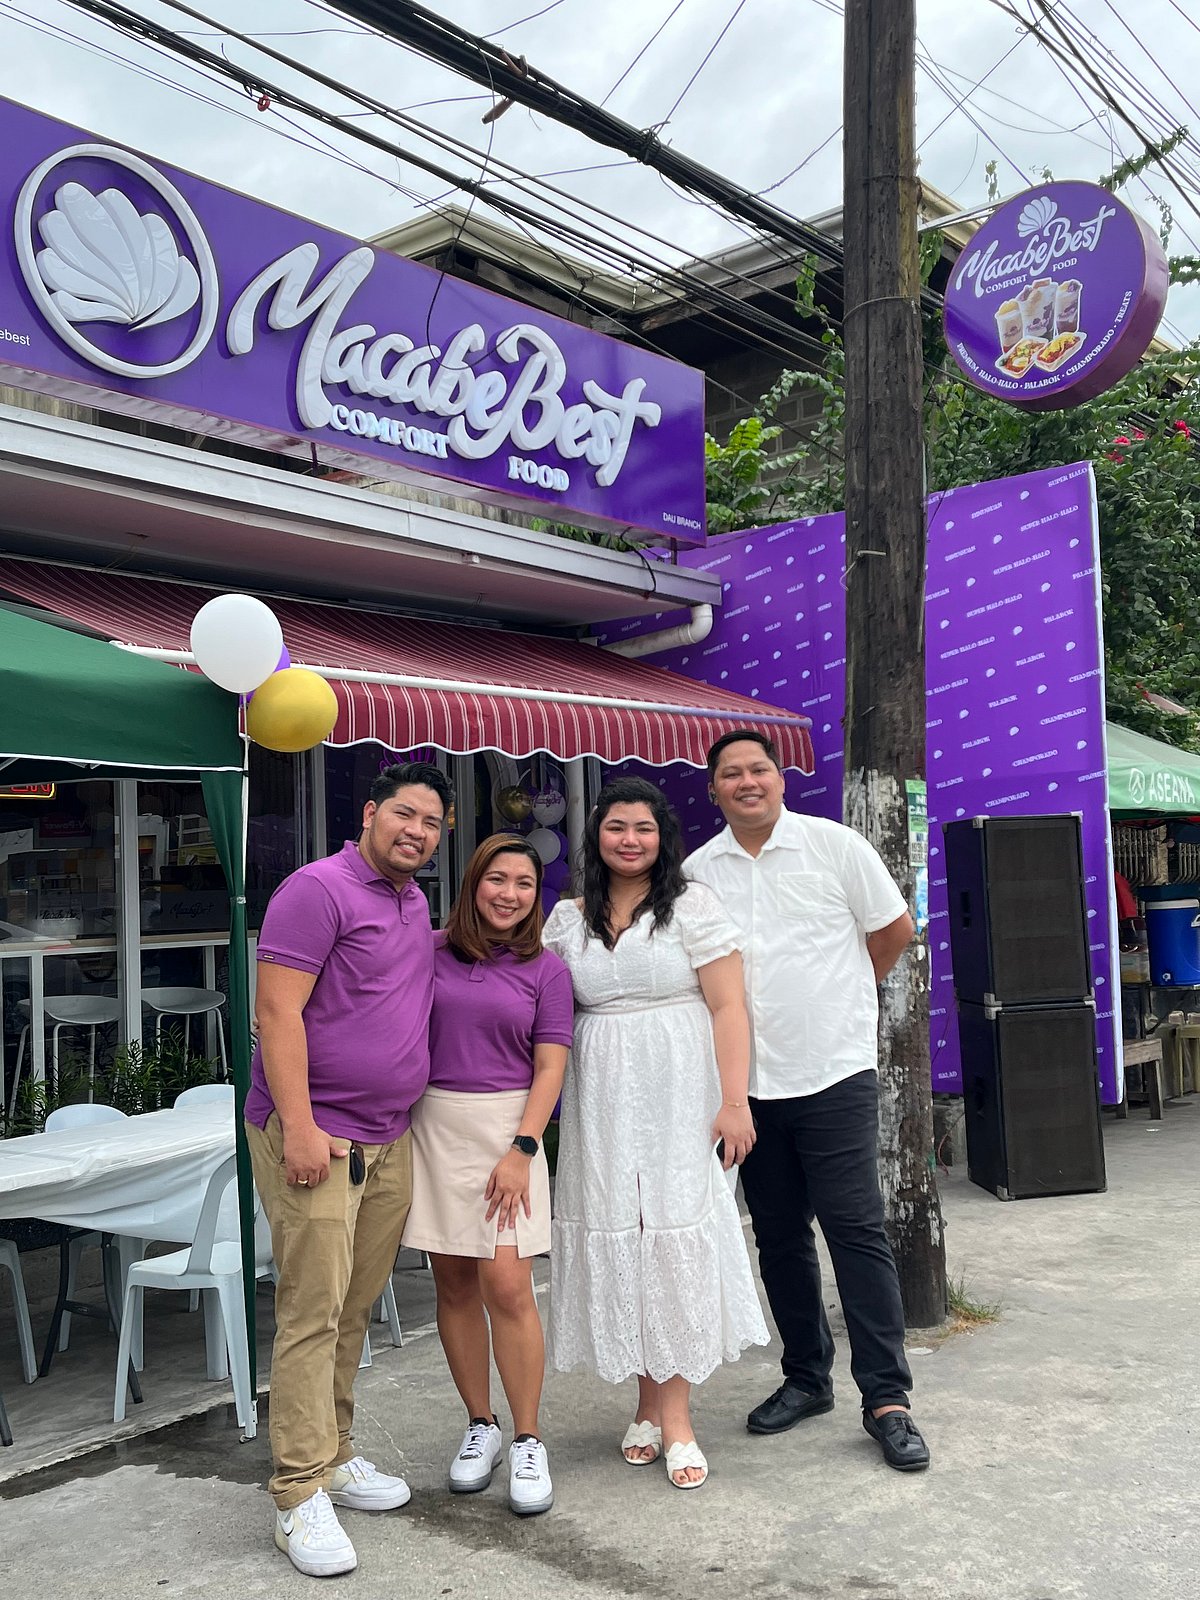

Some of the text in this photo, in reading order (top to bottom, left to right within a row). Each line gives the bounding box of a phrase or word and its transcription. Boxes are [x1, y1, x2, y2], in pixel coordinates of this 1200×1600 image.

[985, 257, 1078, 294] COMFORT FOOD
[956, 290, 1133, 390] PREMIUM HALO-HALO PALABOK CHAMPORADO TREATS
[329, 404, 570, 493] COMFORT FOOD
[662, 511, 702, 530] DAU BRANCH
[1149, 772, 1196, 804] ASEANA
